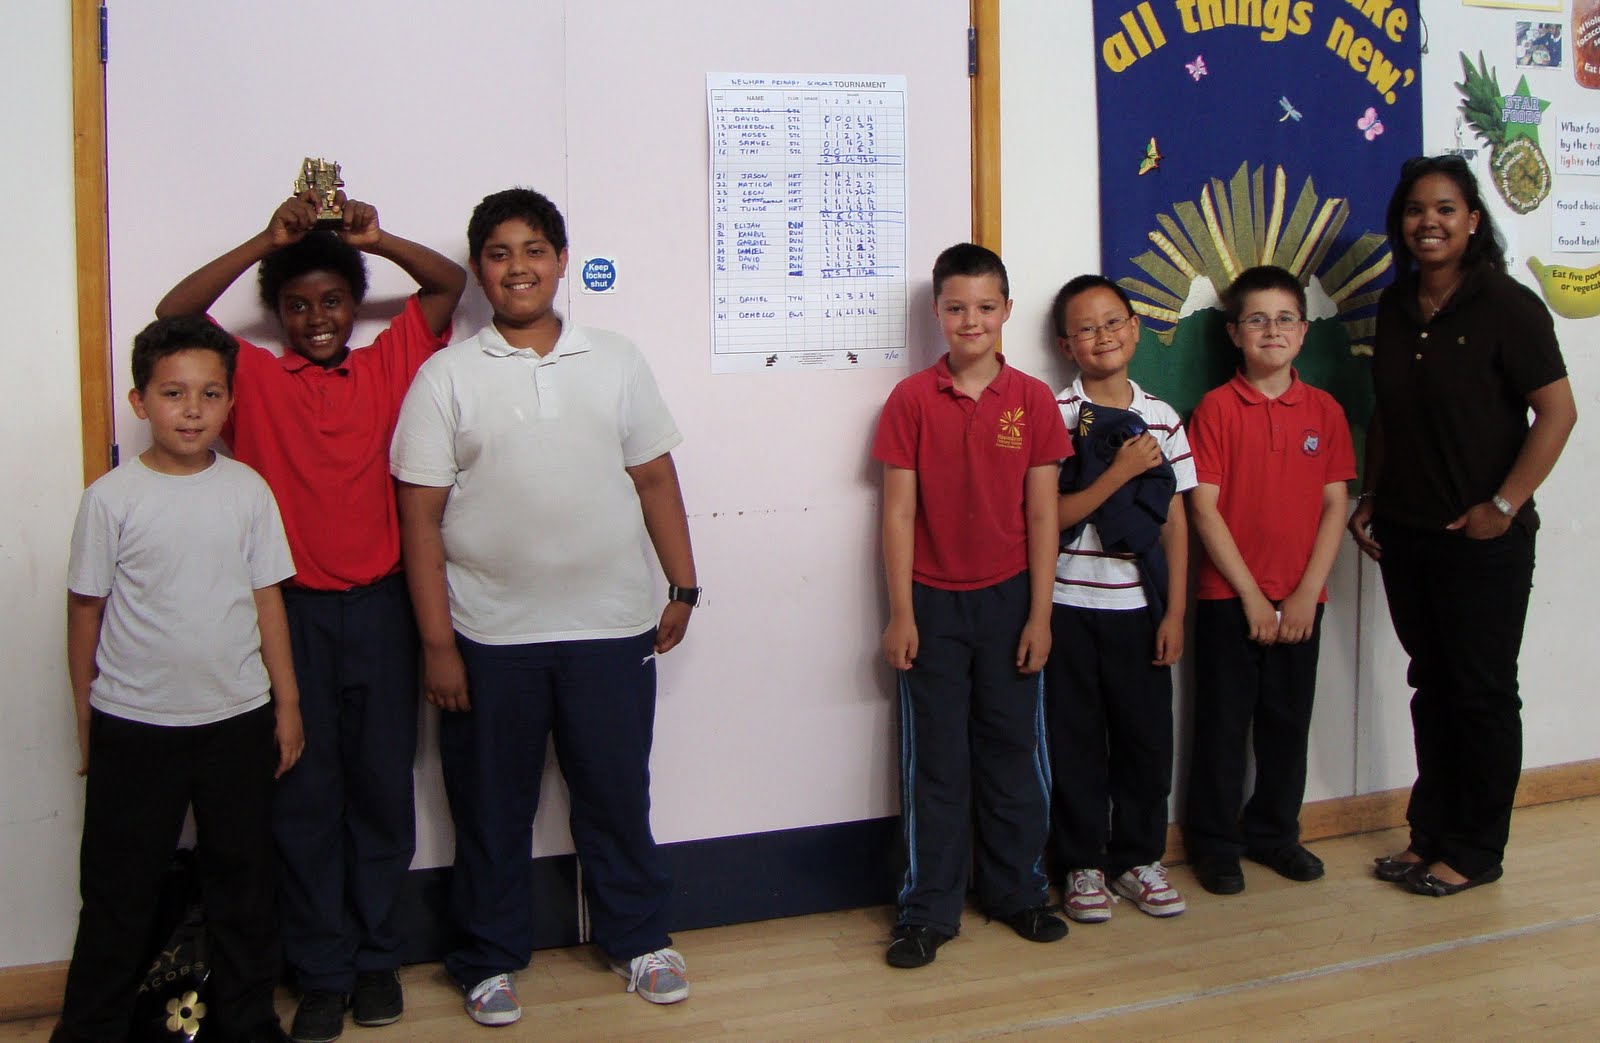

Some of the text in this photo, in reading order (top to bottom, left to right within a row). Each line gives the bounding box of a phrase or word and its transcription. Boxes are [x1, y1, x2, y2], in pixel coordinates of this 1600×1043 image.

[1344, 0, 1408, 42] ke
[1103, 2, 1167, 72] all
[1176, 0, 1314, 41] things
[1505, 95, 1540, 110] STAR
[1502, 109, 1542, 124] FOODS
[1562, 122, 1584, 132] What
[1560, 138, 1570, 152] by
[1574, 138, 1588, 150] the
[1560, 154, 1584, 168] lights
[1557, 200, 1600, 210] Good choic
[1558, 236, 1600, 246] Good healt
[589, 264, 608, 272] Keep
[1552, 270, 1566, 278] Eat
[1568, 272, 1584, 282] five
